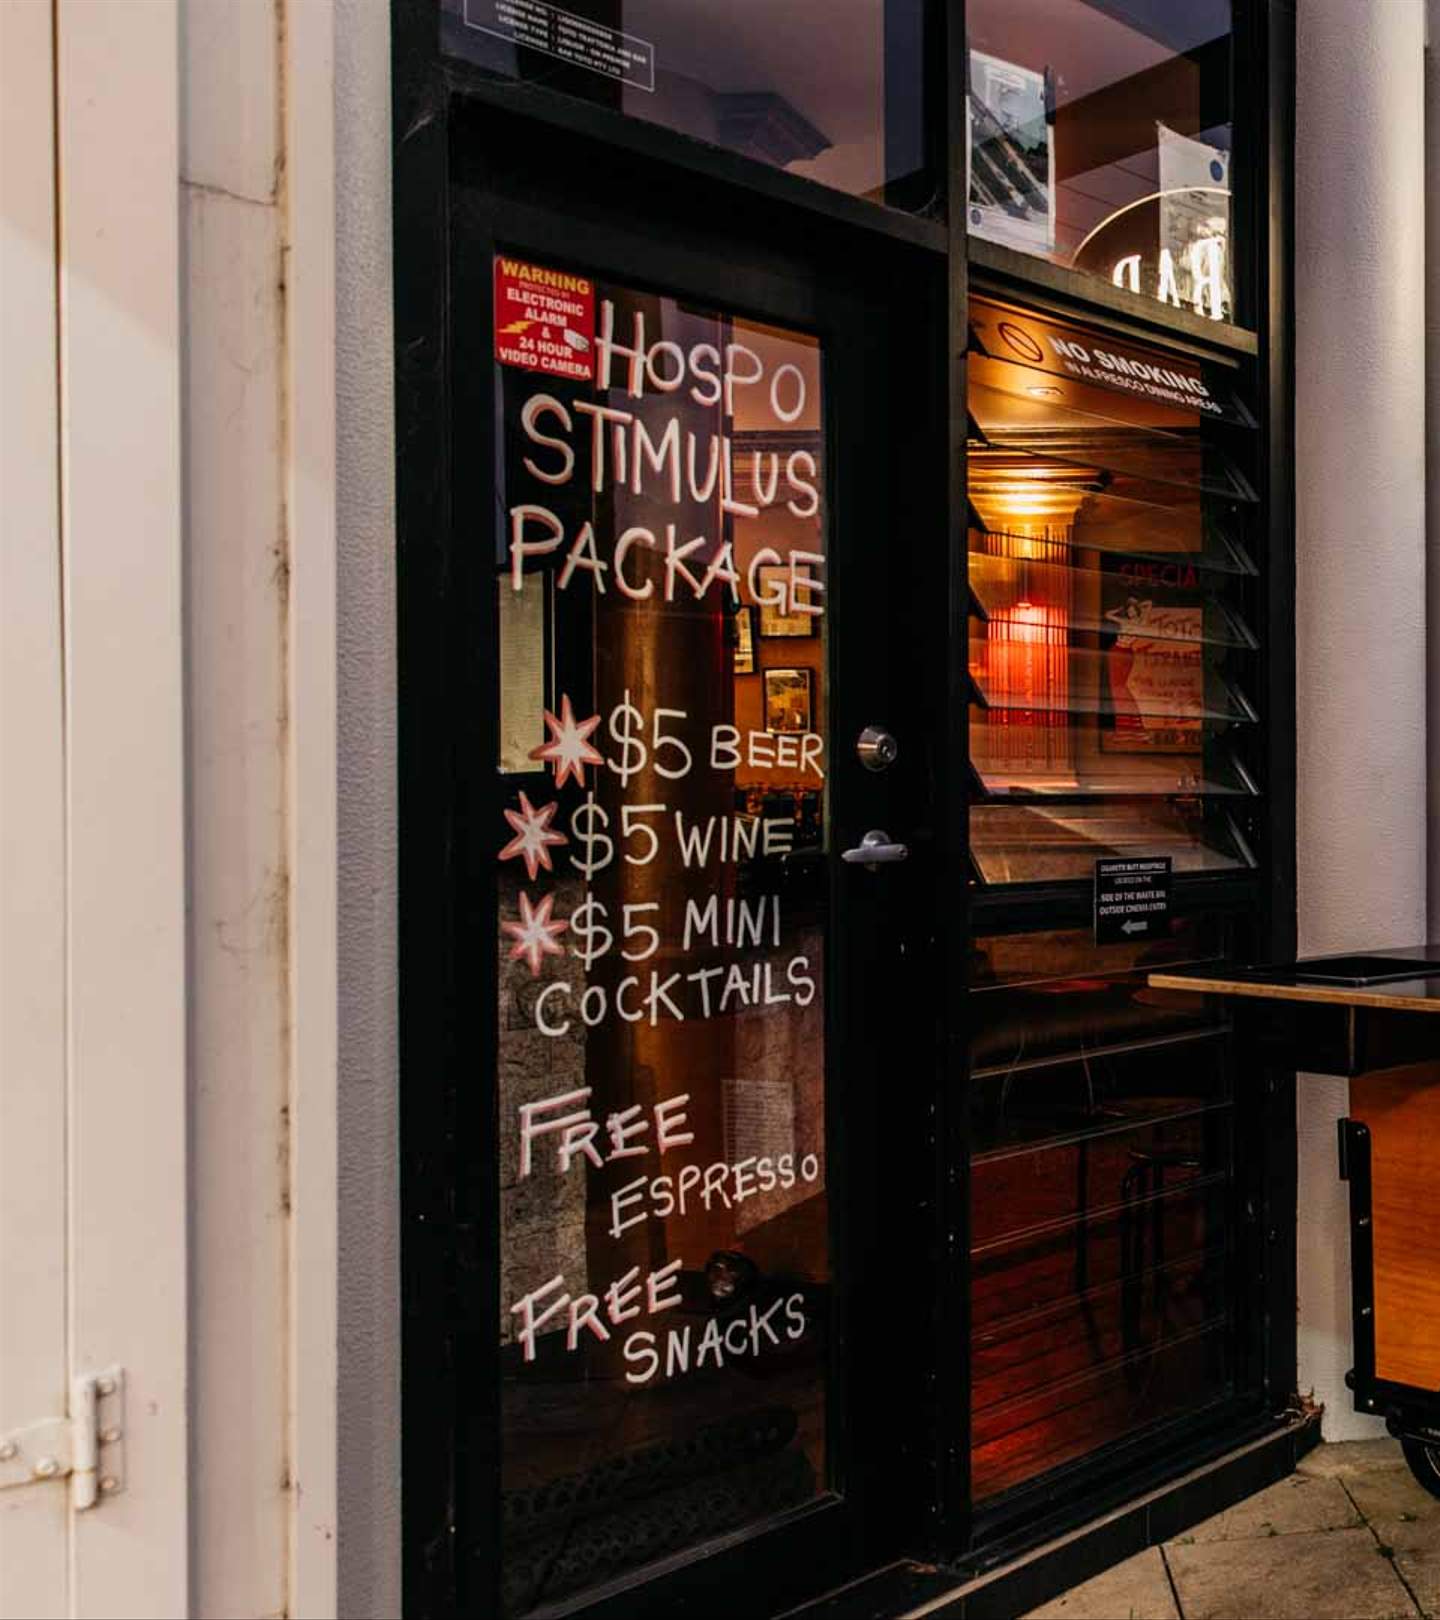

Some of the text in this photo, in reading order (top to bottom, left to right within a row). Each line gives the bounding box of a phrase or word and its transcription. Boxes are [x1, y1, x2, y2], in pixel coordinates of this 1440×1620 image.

[502, 259, 590, 295] WARNING
[506, 287, 584, 317] ELECTRONIC
[525, 306, 568, 328] ALARM
[499, 346, 592, 378] VIDEO CAMERA
[519, 335, 574, 359] 24 HOUR
[541, 326, 551, 339] &
[595, 300, 806, 424] HOSPO
[1049, 335, 1211, 399] NO SMOKING
[521, 393, 819, 519] STIMULUS
[510, 505, 825, 617] PACKAGE
[606, 688, 825, 788] $5 BEER
[569, 791, 796, 882] $5 WINE
[570, 891, 782, 972] $5 MINI
[535, 956, 817, 1037] COCKTAILS
[517, 1087, 696, 1179] FREE
[608, 1153, 819, 1239] ESPRESSO
[510, 1260, 684, 1362] FREE
[622, 1293, 807, 1384] SNACKS
